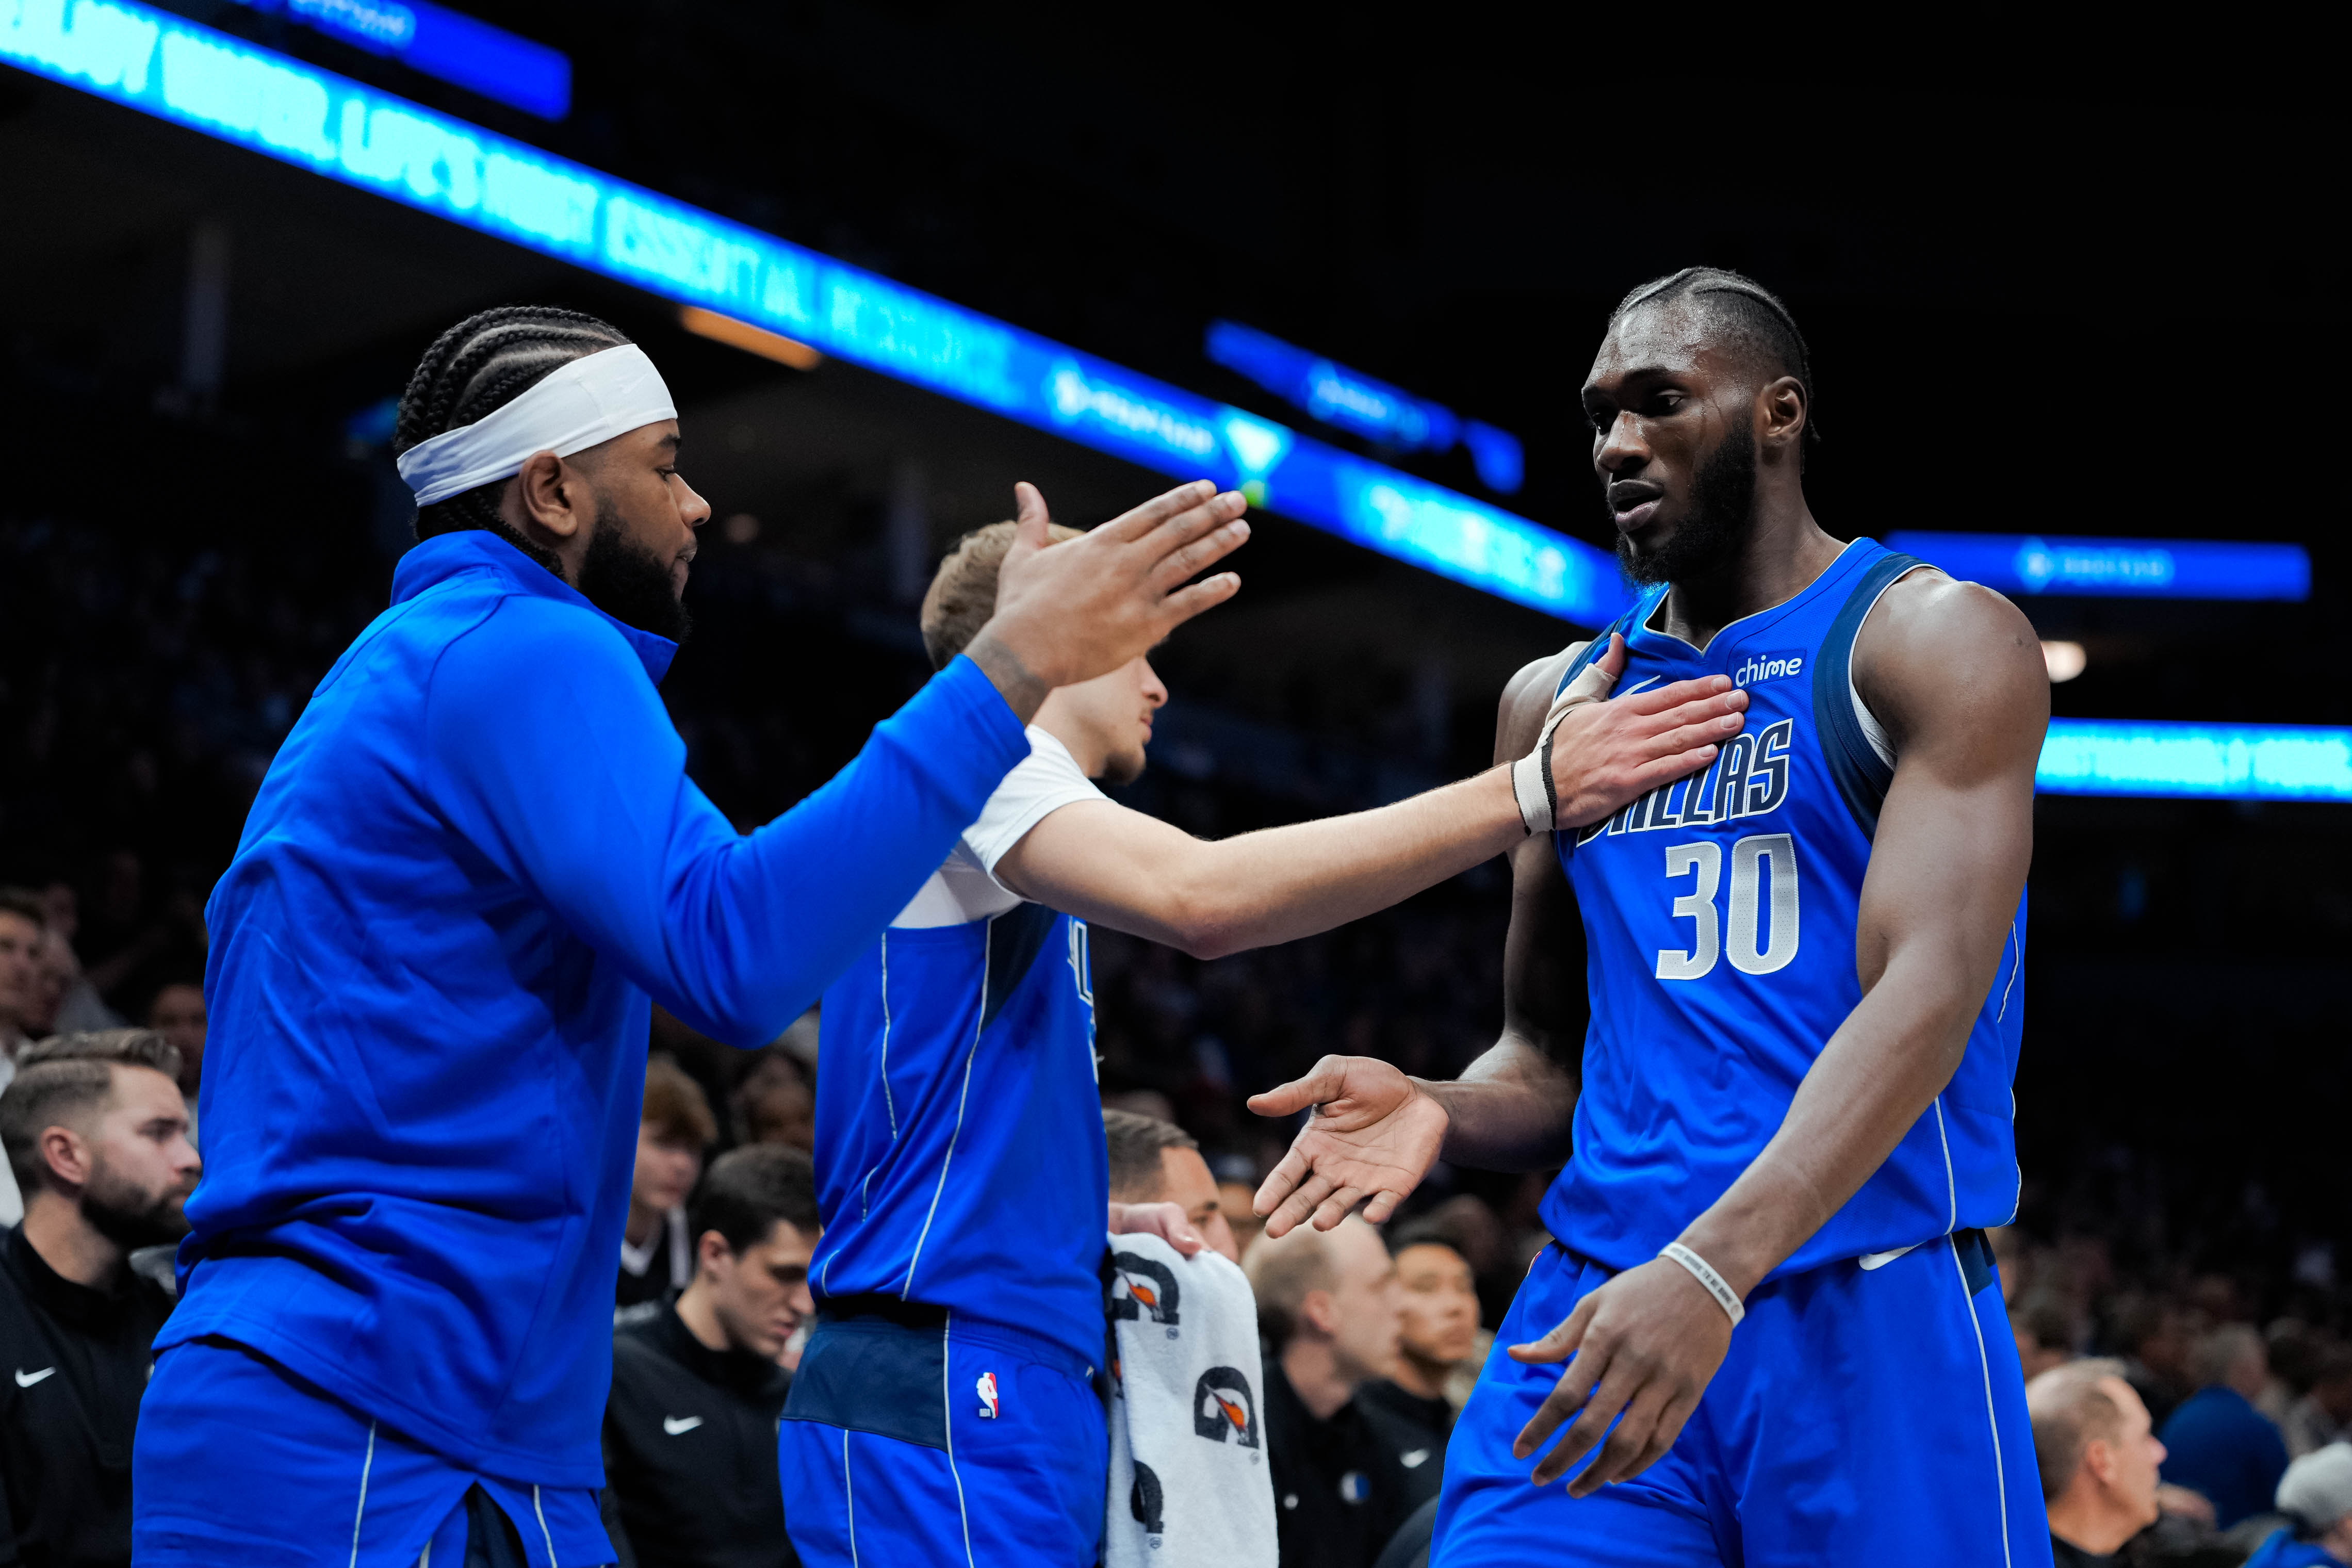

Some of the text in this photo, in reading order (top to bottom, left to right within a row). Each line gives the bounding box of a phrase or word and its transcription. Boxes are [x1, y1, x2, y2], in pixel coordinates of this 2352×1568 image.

[1736, 655, 1802, 688] chime
[1576, 718, 1793, 848] LLAS
[1656, 833, 1800, 981] 30
